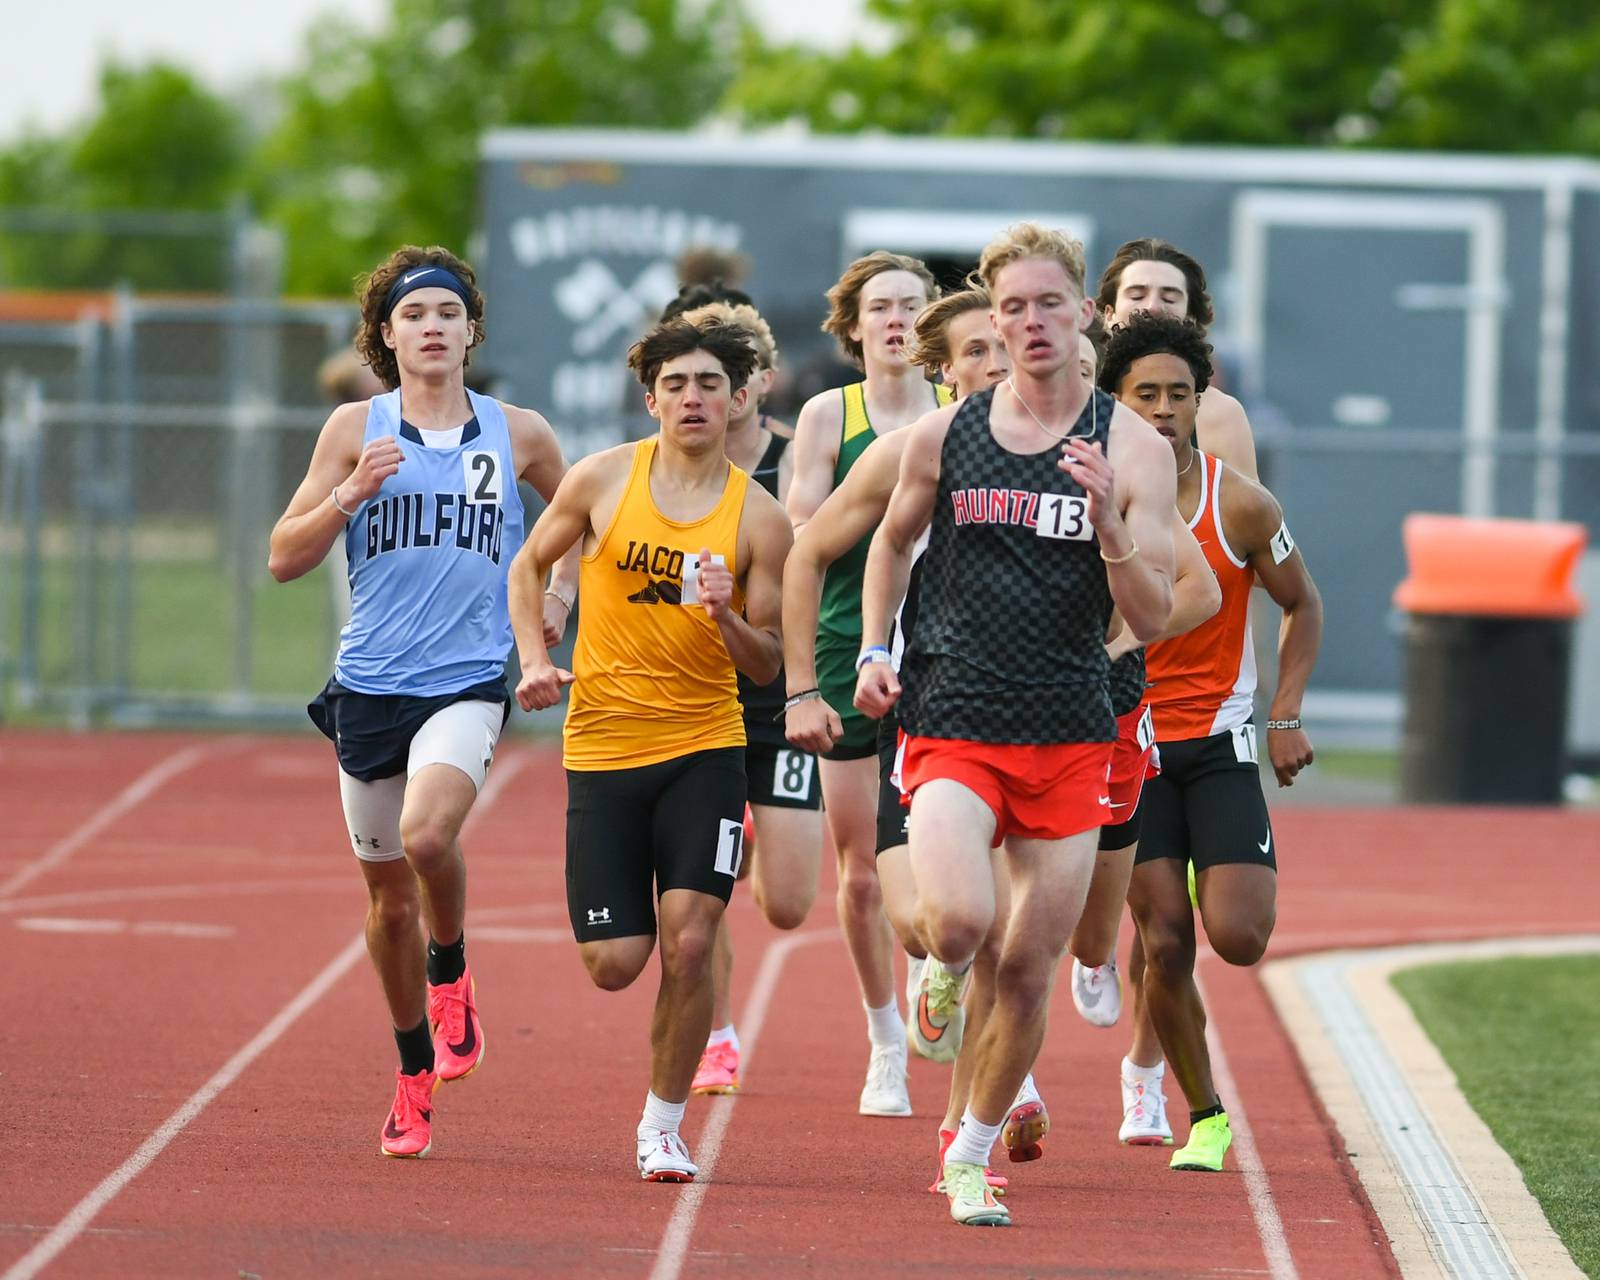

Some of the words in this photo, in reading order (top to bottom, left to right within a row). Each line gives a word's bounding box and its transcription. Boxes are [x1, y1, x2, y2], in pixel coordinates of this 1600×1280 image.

[472, 454, 497, 500] 2
[365, 492, 504, 566] GUILFORD
[951, 488, 1039, 528] HUNTL
[1050, 498, 1085, 537] 13
[782, 750, 806, 793] 8
